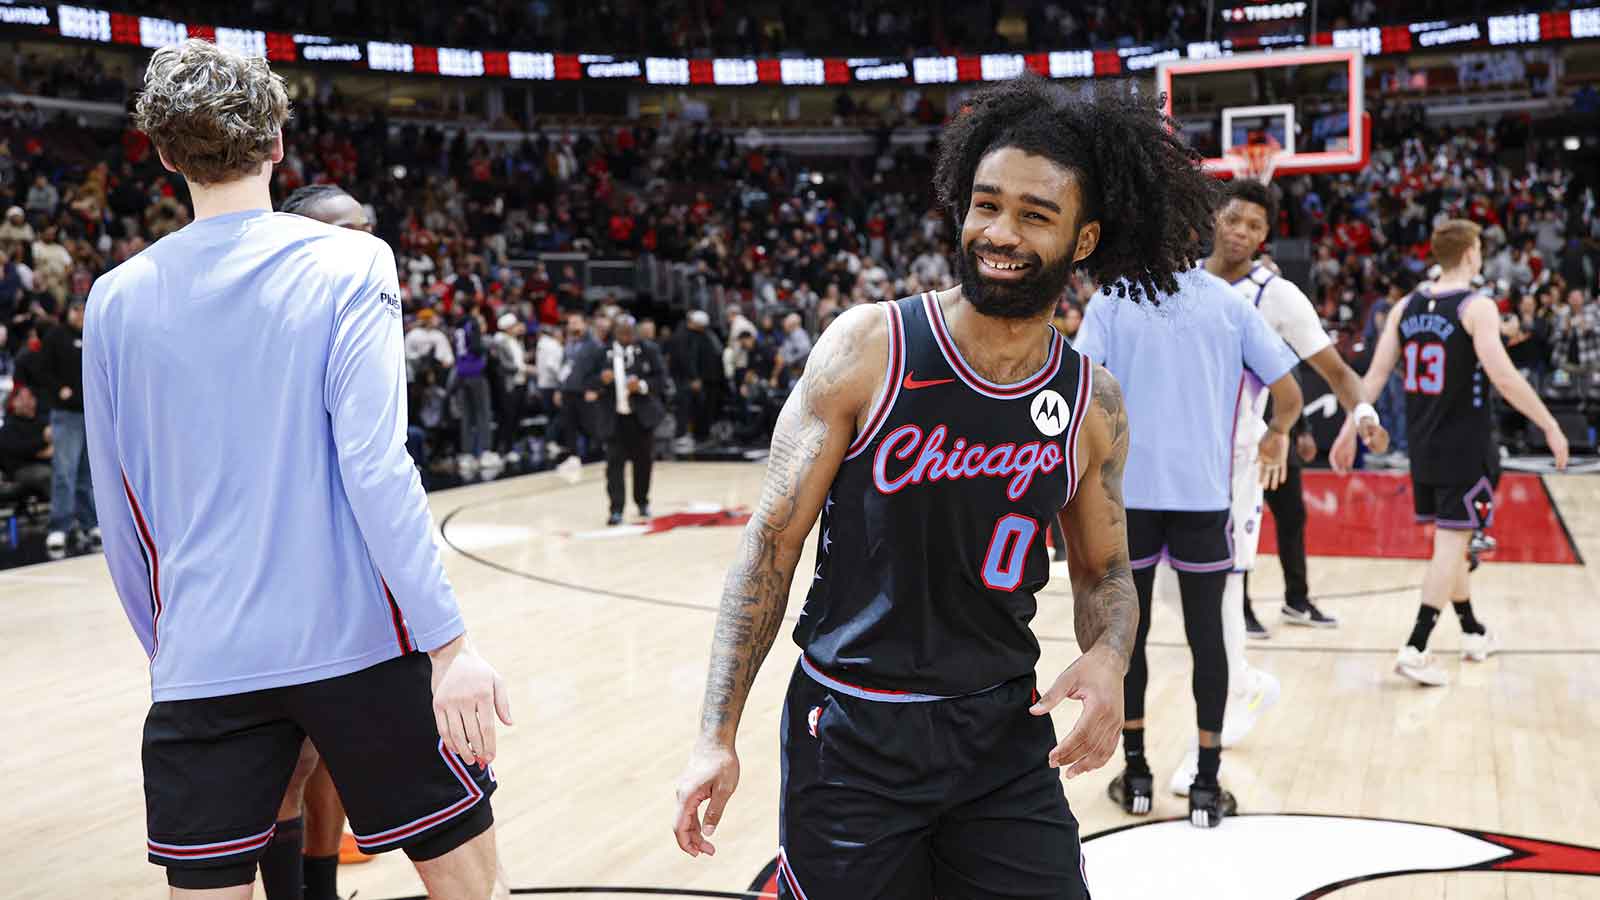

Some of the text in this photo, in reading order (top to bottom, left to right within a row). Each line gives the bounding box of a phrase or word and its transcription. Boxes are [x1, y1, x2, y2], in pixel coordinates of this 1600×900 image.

[1403, 341, 1446, 394] 13
[873, 424, 1064, 501] Chicago
[980, 512, 1039, 592] 0
